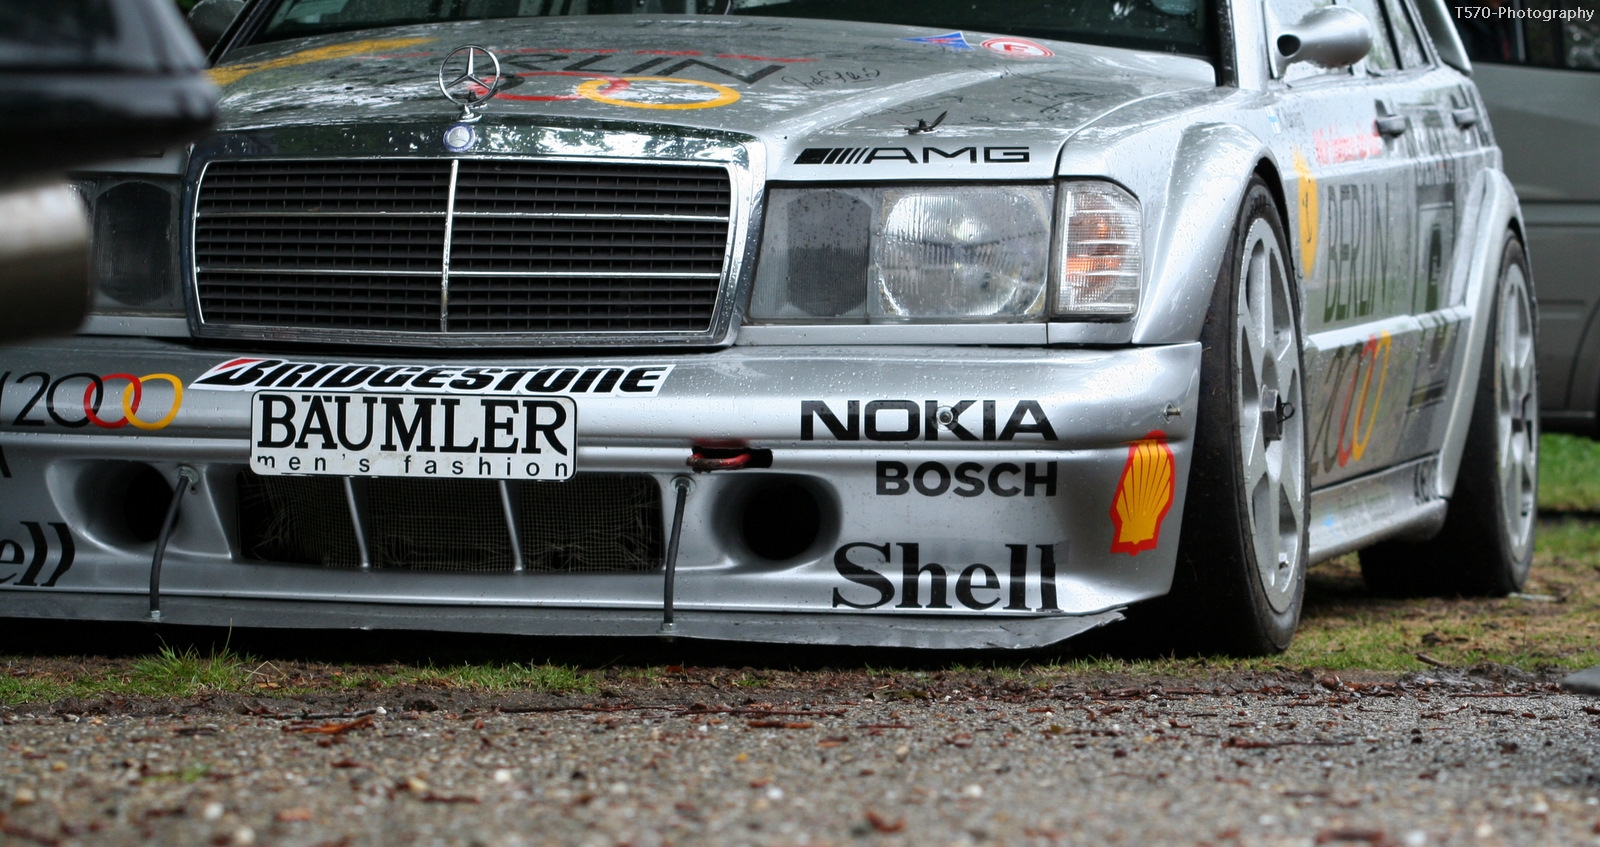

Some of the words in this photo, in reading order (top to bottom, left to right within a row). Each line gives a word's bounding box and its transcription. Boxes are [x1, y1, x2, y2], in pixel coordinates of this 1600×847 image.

[862, 146, 1030, 164] AMG
[1324, 182, 1390, 323] BERLIN
[194, 357, 670, 395] BRIDGESTONE
[11, 371, 184, 430] 2000
[800, 399, 1059, 442] NOKIA
[256, 394, 569, 457] BÄUMLER
[256, 453, 371, 474] men's
[404, 454, 569, 478] fashion
[875, 459, 1058, 498] BOSCH
[831, 541, 1064, 613] Shell
